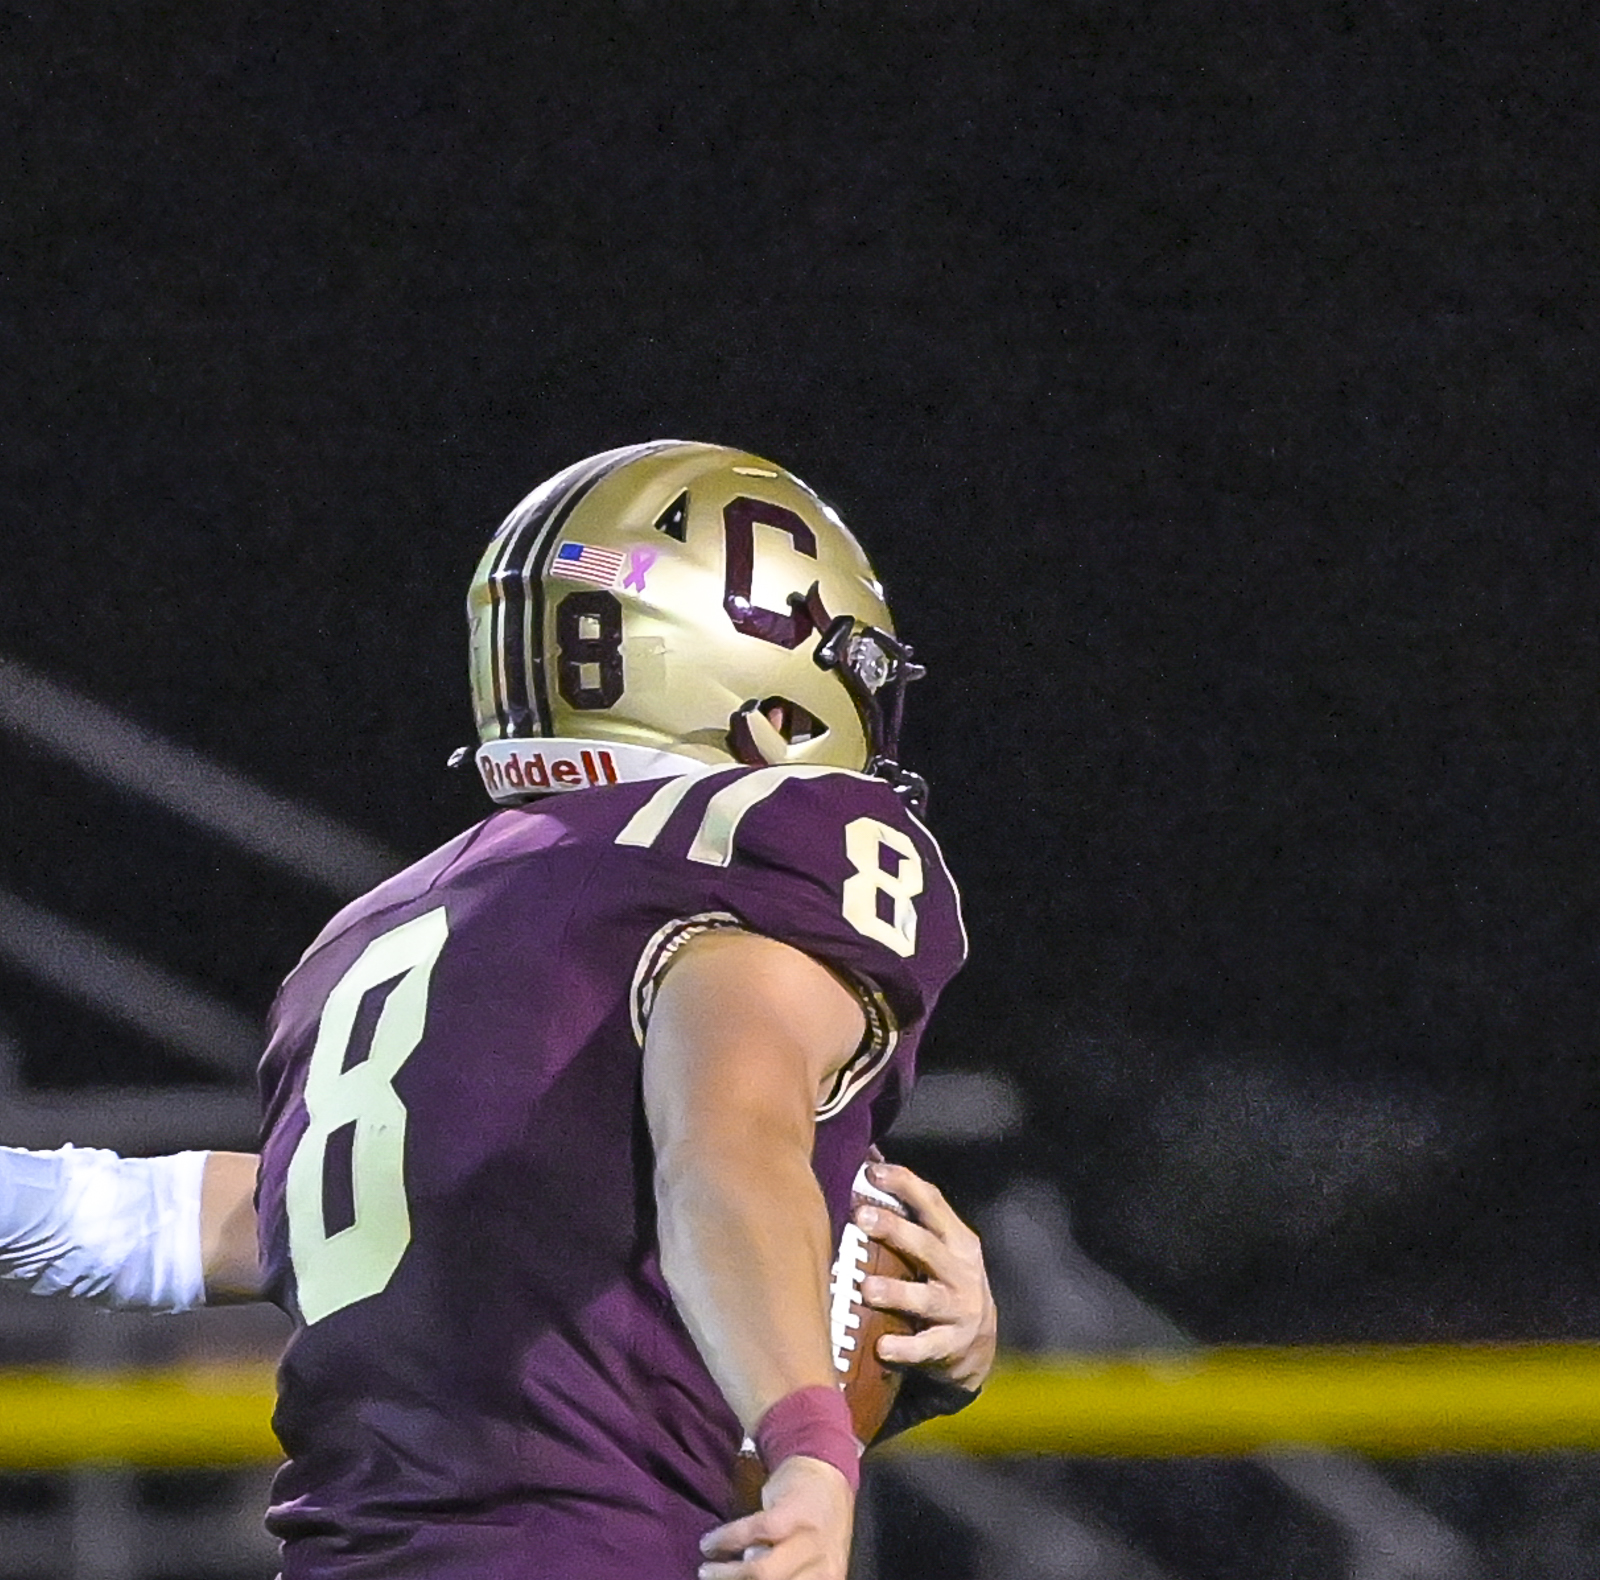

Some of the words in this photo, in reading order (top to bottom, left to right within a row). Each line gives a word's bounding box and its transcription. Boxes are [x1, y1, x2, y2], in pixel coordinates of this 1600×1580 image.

[555, 590, 624, 709] 8
[480, 751, 617, 790] Riddell
[842, 816, 924, 958] 8
[286, 906, 449, 1327] 8
